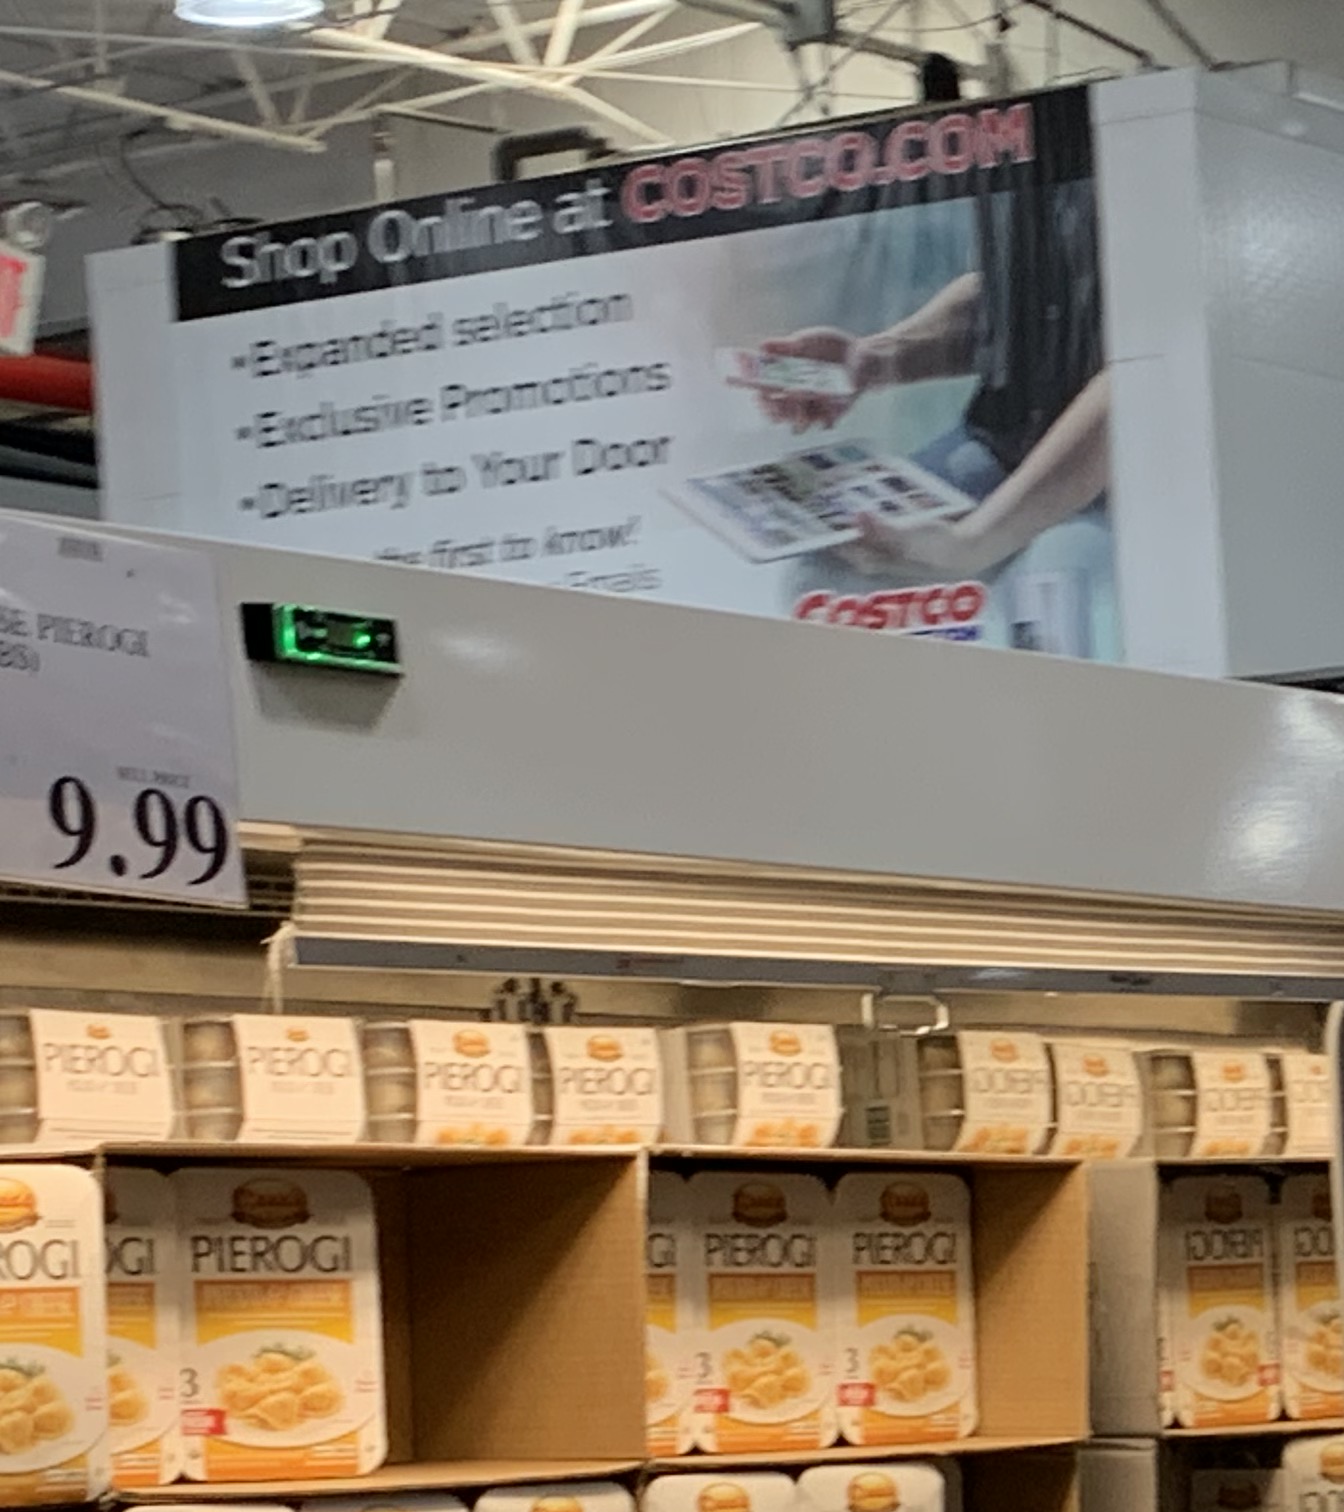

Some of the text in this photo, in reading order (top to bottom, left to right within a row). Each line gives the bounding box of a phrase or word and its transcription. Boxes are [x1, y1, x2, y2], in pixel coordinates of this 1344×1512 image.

[220, 102, 1036, 288] Shop Online at COSTCO.COM
[250, 291, 635, 380] Expanded selection
[253, 361, 674, 449] Exclusive Promotions
[259, 435, 677, 519] Delivery to Your Door
[499, 533, 537, 562] to
[796, 581, 986, 630] COSTCO
[37, 612, 151, 658] PIEROGI
[48, 776, 228, 886] 9.99
[44, 1042, 160, 1078] PIEROGI
[247, 1044, 353, 1080] PIEROGI
[424, 1060, 524, 1095] PIEROGI
[560, 1066, 656, 1099] PIEROGI
[191, 1234, 352, 1273] PIEROGI
[705, 1233, 817, 1269] PIEROGI
[853, 1231, 957, 1266] PIEROGI
